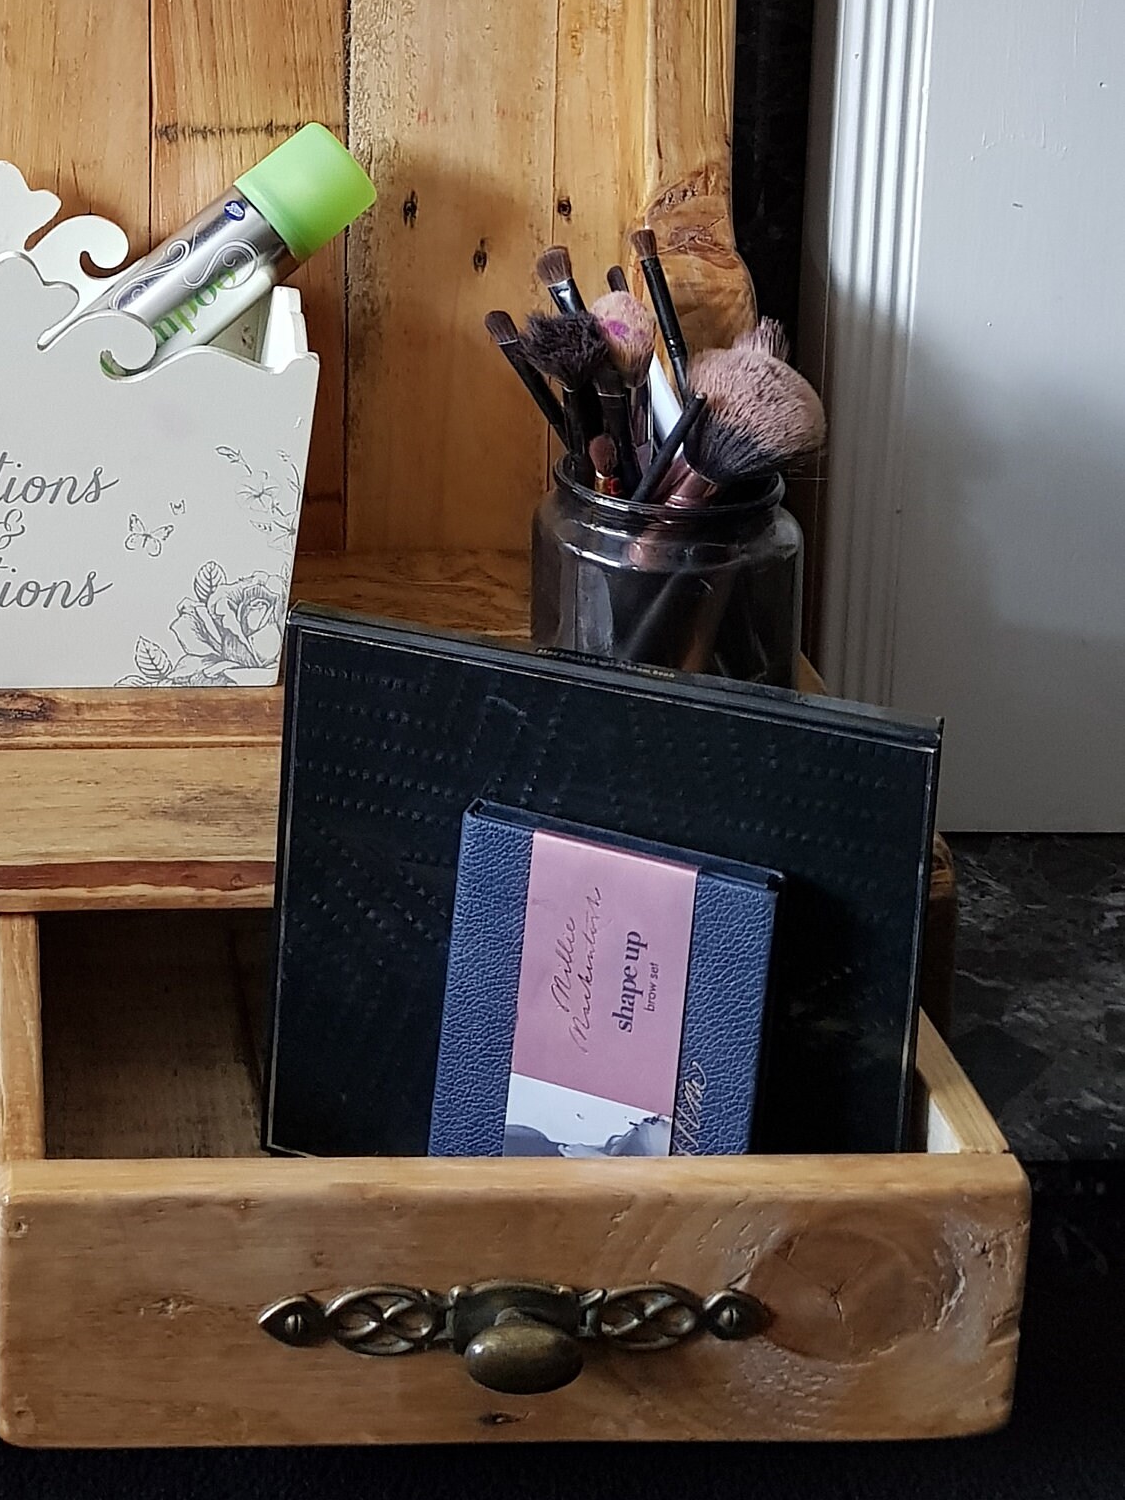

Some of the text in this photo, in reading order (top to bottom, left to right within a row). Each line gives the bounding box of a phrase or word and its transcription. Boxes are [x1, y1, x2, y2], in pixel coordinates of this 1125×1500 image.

[550, 916, 576, 1013] Millie
[611, 930, 649, 1033] shape up
[643, 961, 660, 1012] brow set
